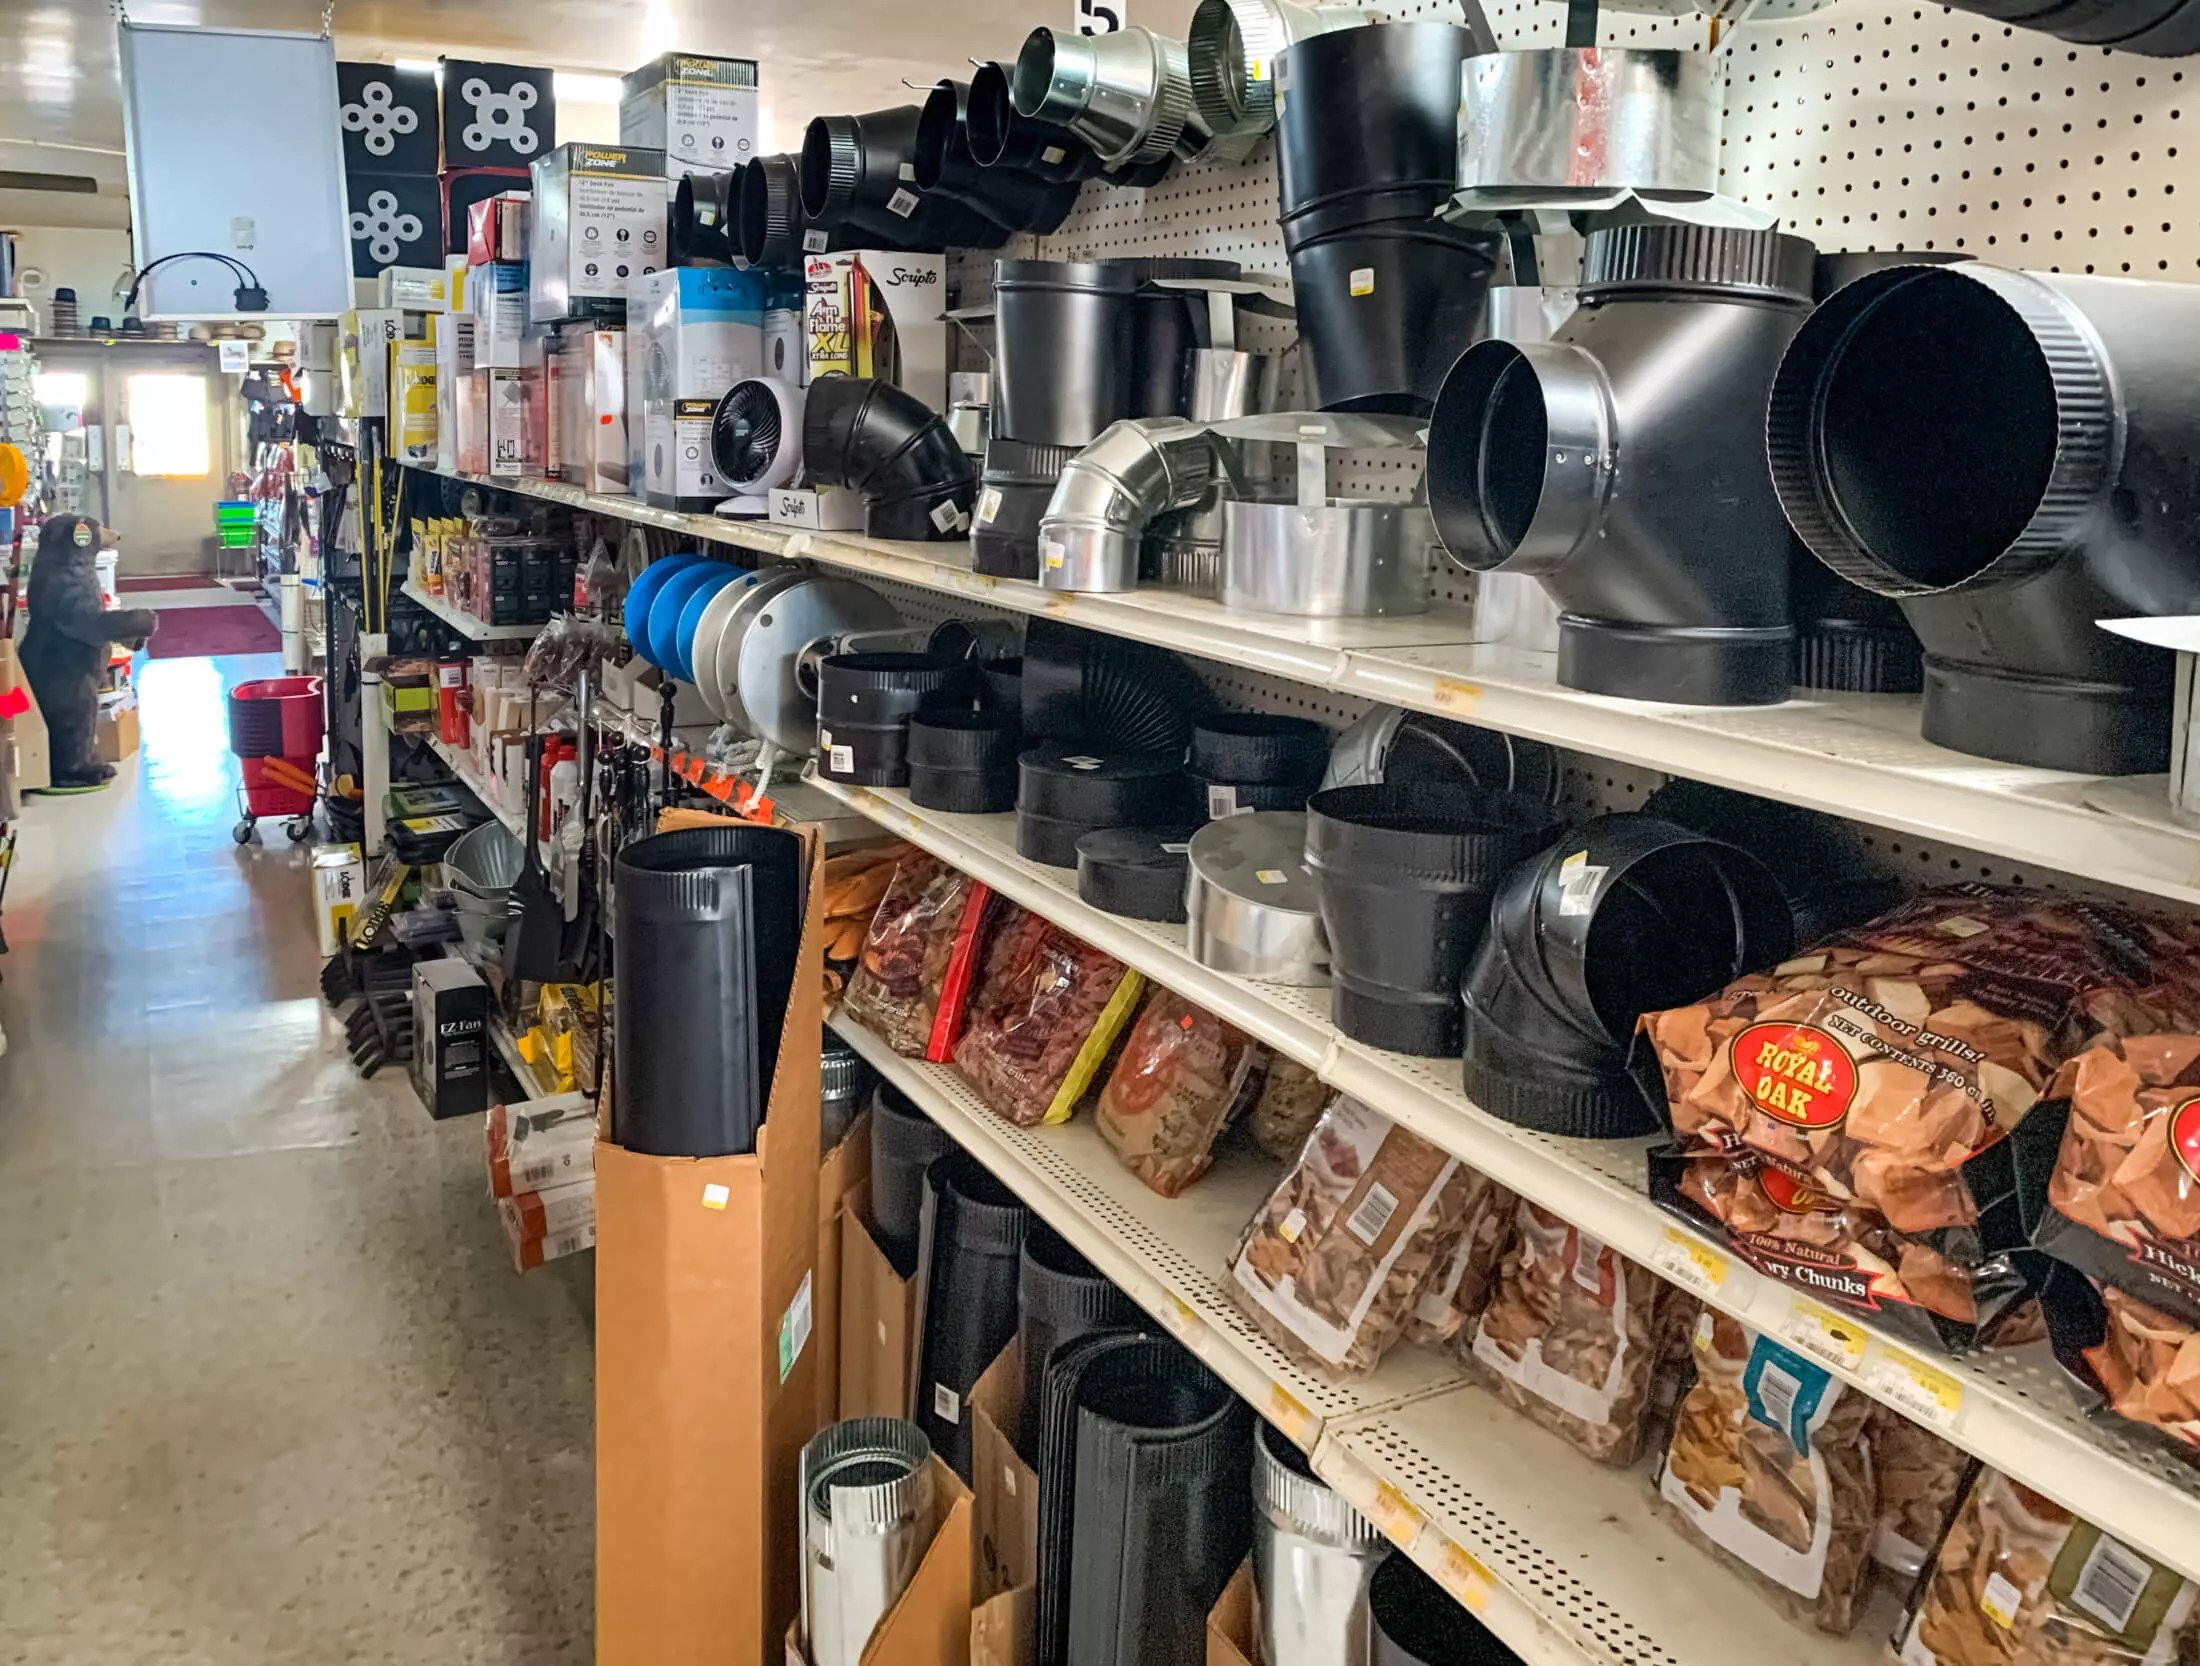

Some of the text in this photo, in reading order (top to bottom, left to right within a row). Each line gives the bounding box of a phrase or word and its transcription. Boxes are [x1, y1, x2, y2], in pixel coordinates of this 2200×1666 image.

[1080, 0, 1119, 37] 5
[585, 151, 627, 164] POWER
[585, 159, 617, 168] ZONE
[886, 267, 938, 288] Scripto
[384, 319, 398, 340] LOD
[809, 318, 847, 334] Flame
[810, 332, 850, 353] XL
[830, 352, 849, 361] LONG
[1829, 985, 1988, 1064] outdoor grills!
[1828, 1014, 1863, 1037] NET
[1860, 1031, 1938, 1075] CONTENTS
[1755, 1040, 1835, 1095] ROYAL
[1756, 1075, 1813, 1121] OAK
[1749, 1233, 1841, 1267] 100% Natural
[1794, 1265, 1868, 1298] Chunks
